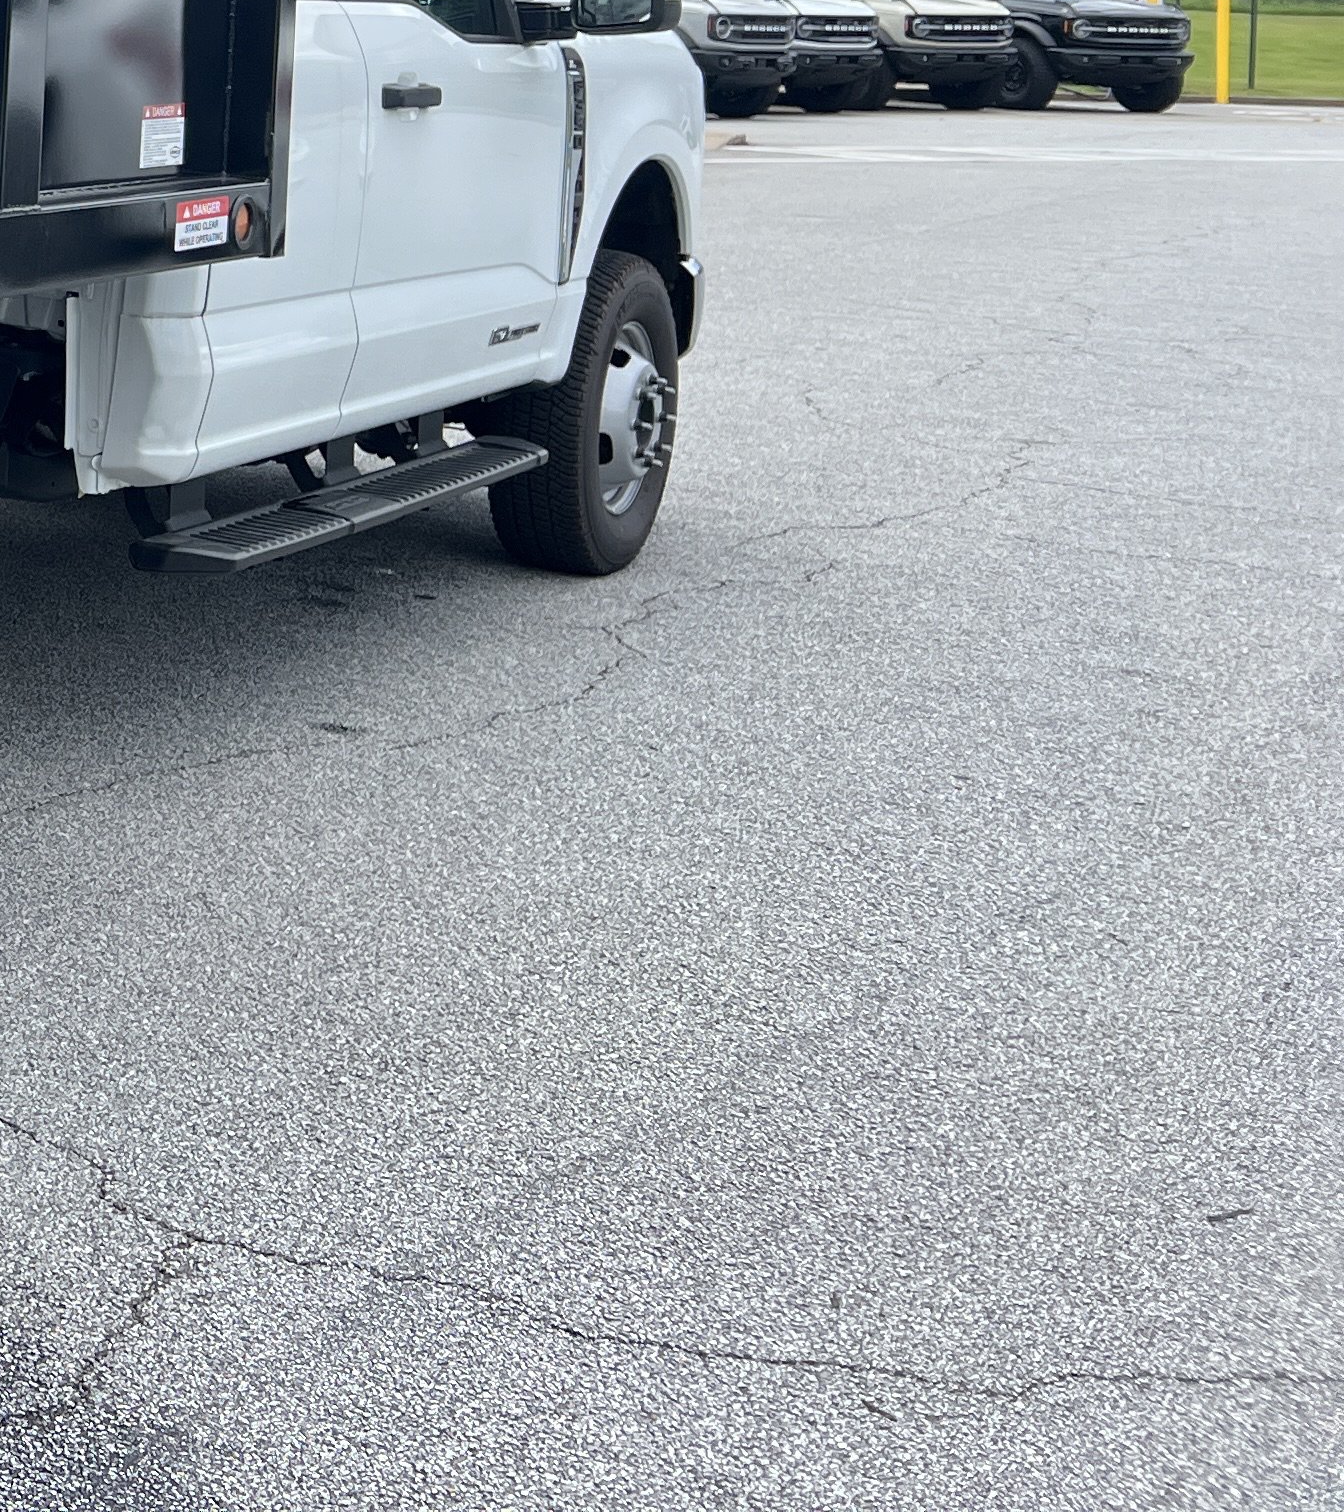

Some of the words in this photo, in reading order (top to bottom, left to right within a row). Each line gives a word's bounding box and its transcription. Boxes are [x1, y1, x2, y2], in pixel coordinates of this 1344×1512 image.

[152, 105, 175, 118] DANGER
[192, 200, 221, 217] DANGER
[184, 222, 202, 233] STAND
[202, 219, 219, 231] CLEAR
